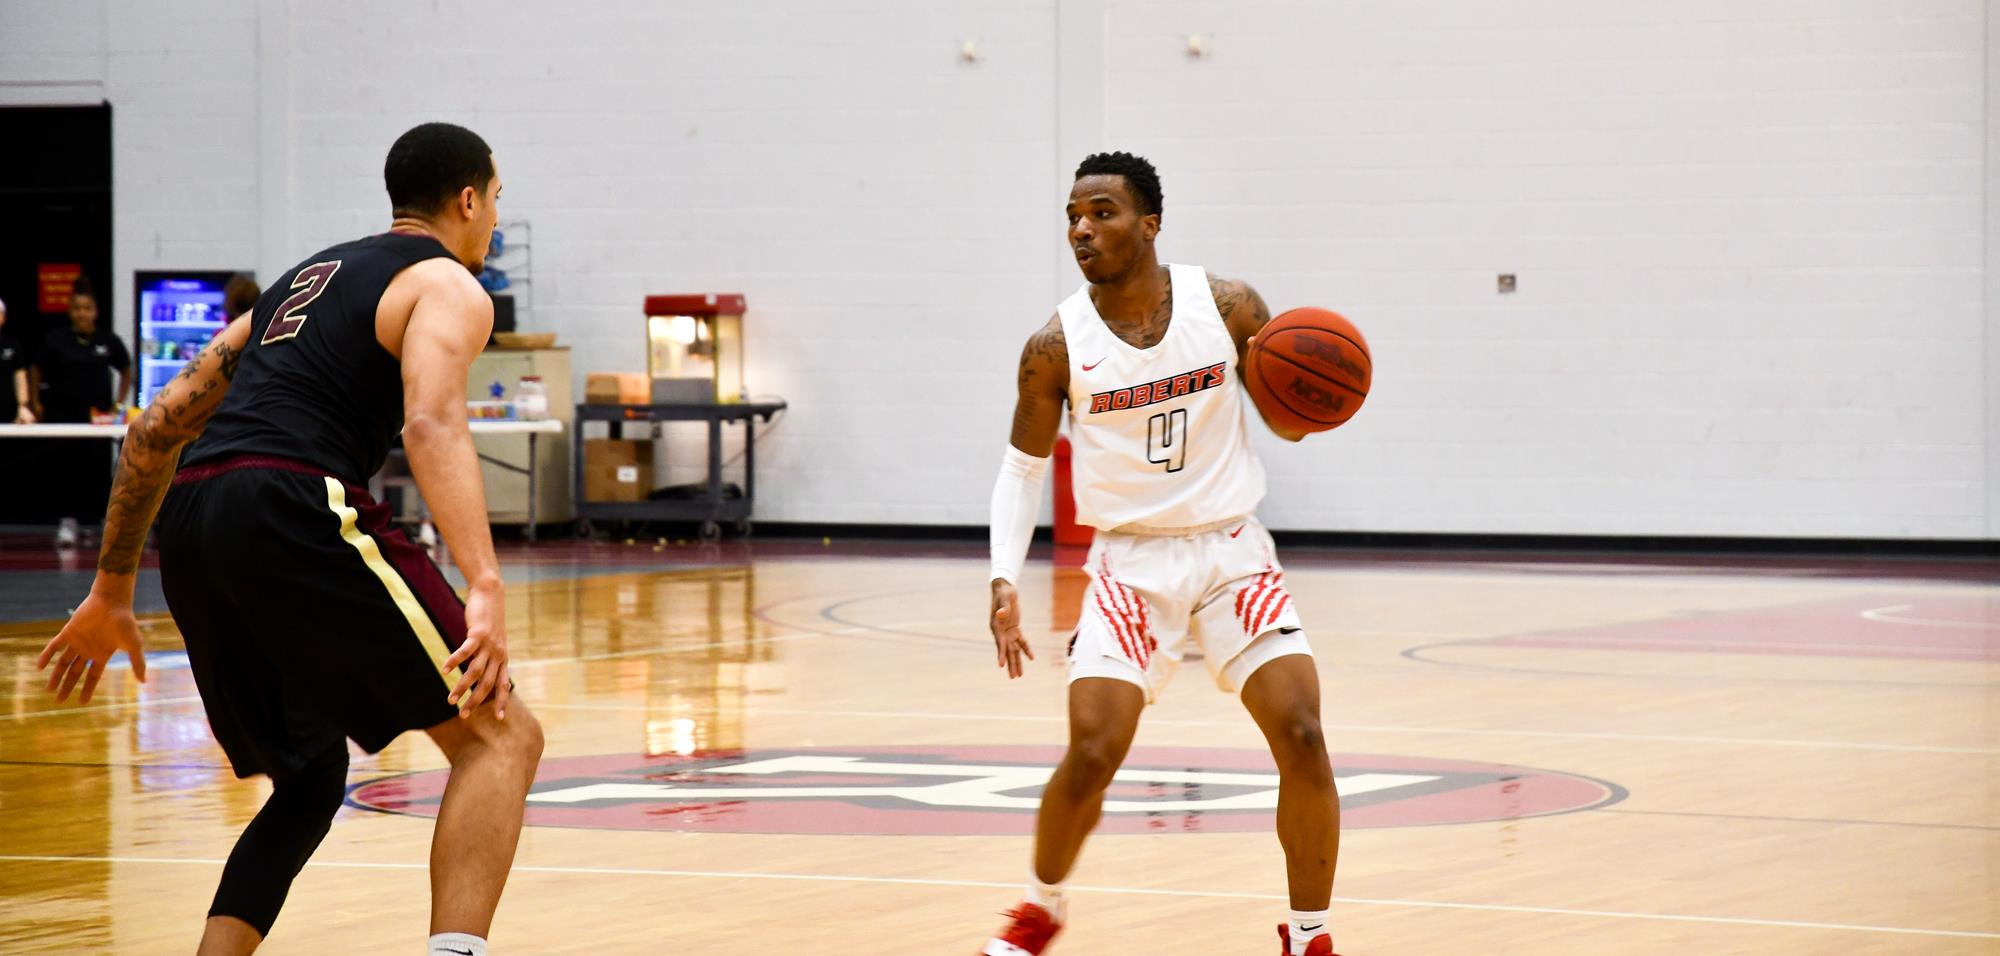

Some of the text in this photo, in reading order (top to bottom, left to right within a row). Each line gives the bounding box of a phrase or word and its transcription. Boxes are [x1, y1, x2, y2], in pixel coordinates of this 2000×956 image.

[260, 259, 342, 345] 2
[1089, 361, 1226, 414] ROBERTS
[1147, 408, 1187, 473] 4
